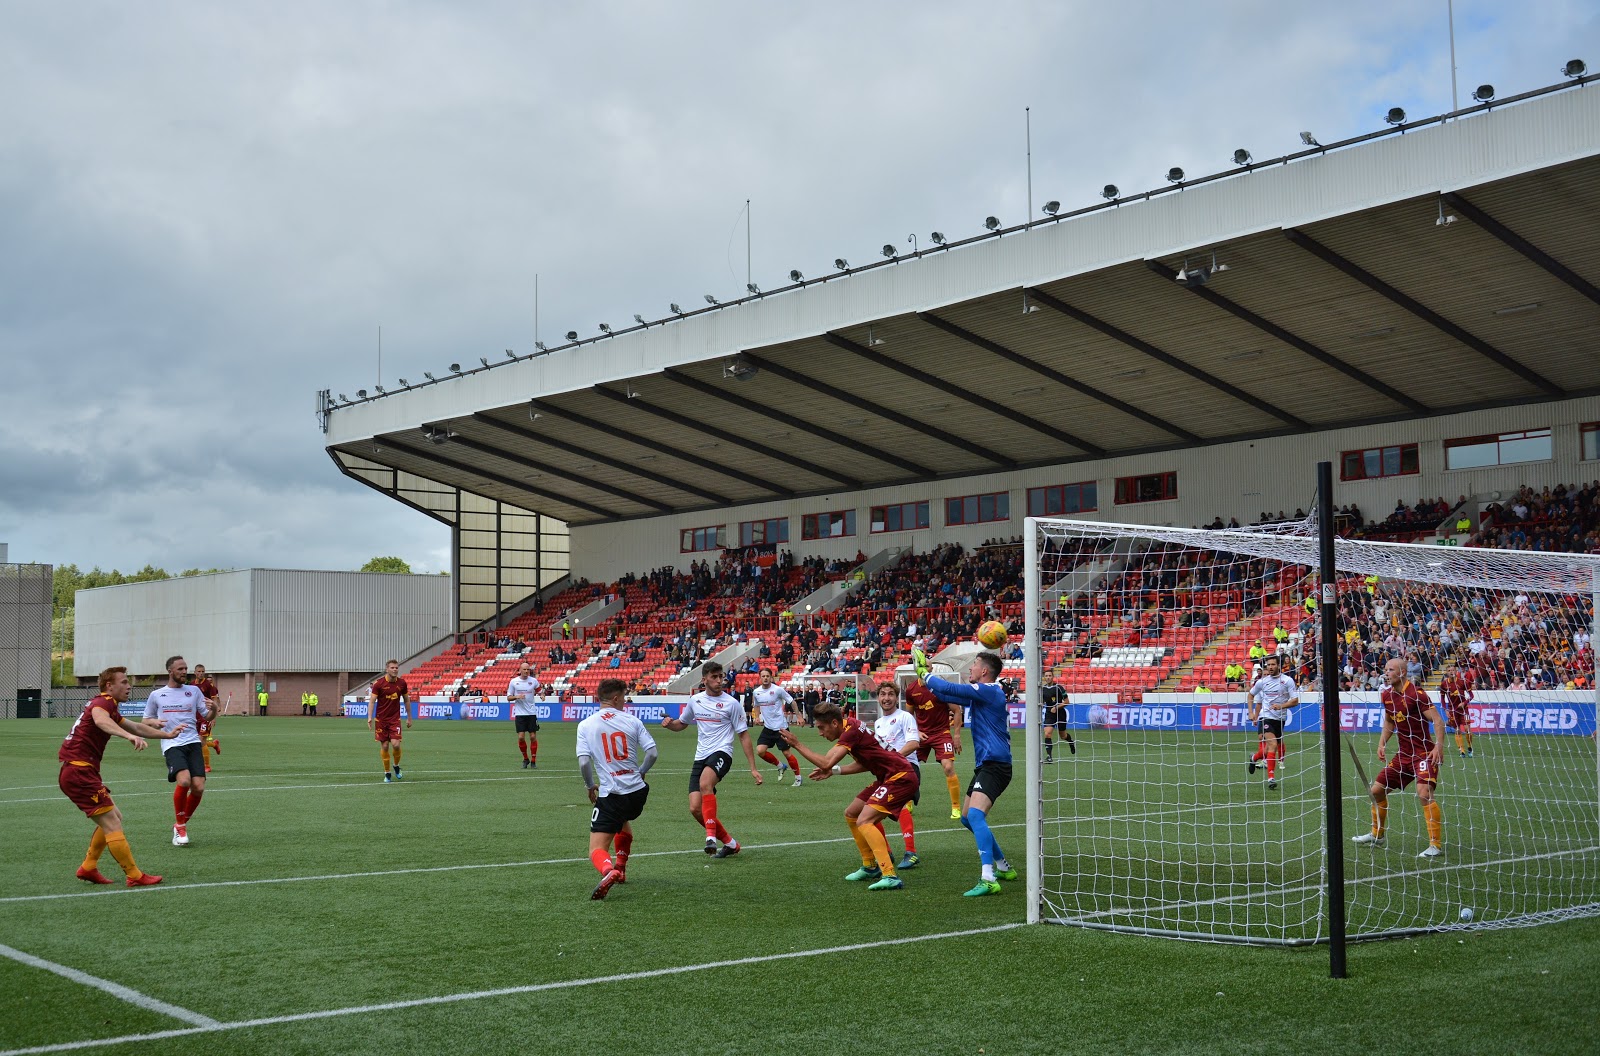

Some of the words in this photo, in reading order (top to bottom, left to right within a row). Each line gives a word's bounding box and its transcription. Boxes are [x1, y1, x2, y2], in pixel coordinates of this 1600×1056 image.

[345, 704, 368, 716] ETFRED
[468, 705, 500, 718] ETFRED
[1105, 708, 1176, 726] ETFRED
[1469, 708, 1578, 729] BETFRED
[396, 727, 401, 735] 7
[601, 731, 629, 763] 10
[943, 742, 953, 752] 19
[1419, 760, 1427, 771] 9
[591, 807, 600, 822] 0
